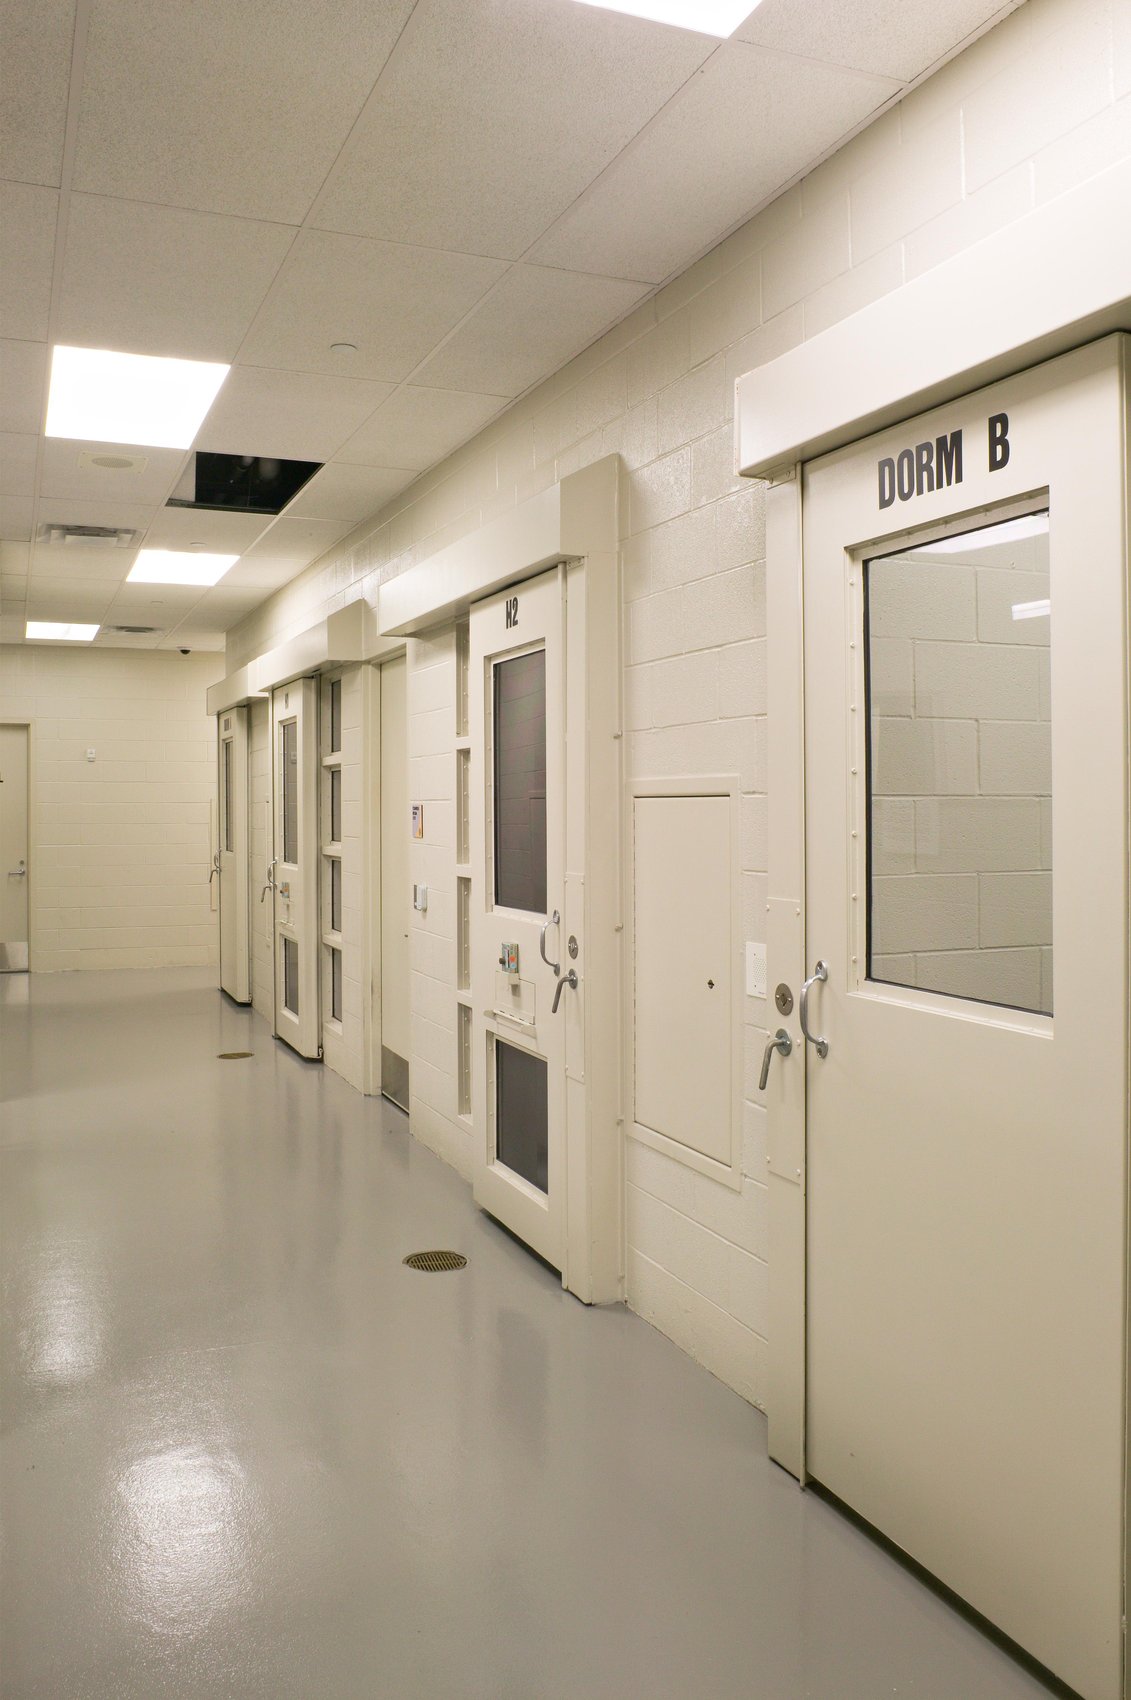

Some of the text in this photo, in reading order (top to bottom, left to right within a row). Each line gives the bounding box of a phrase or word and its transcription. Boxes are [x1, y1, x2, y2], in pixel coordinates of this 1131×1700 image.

[878, 412, 1010, 510] DORM B
[506, 597, 518, 629] H2
